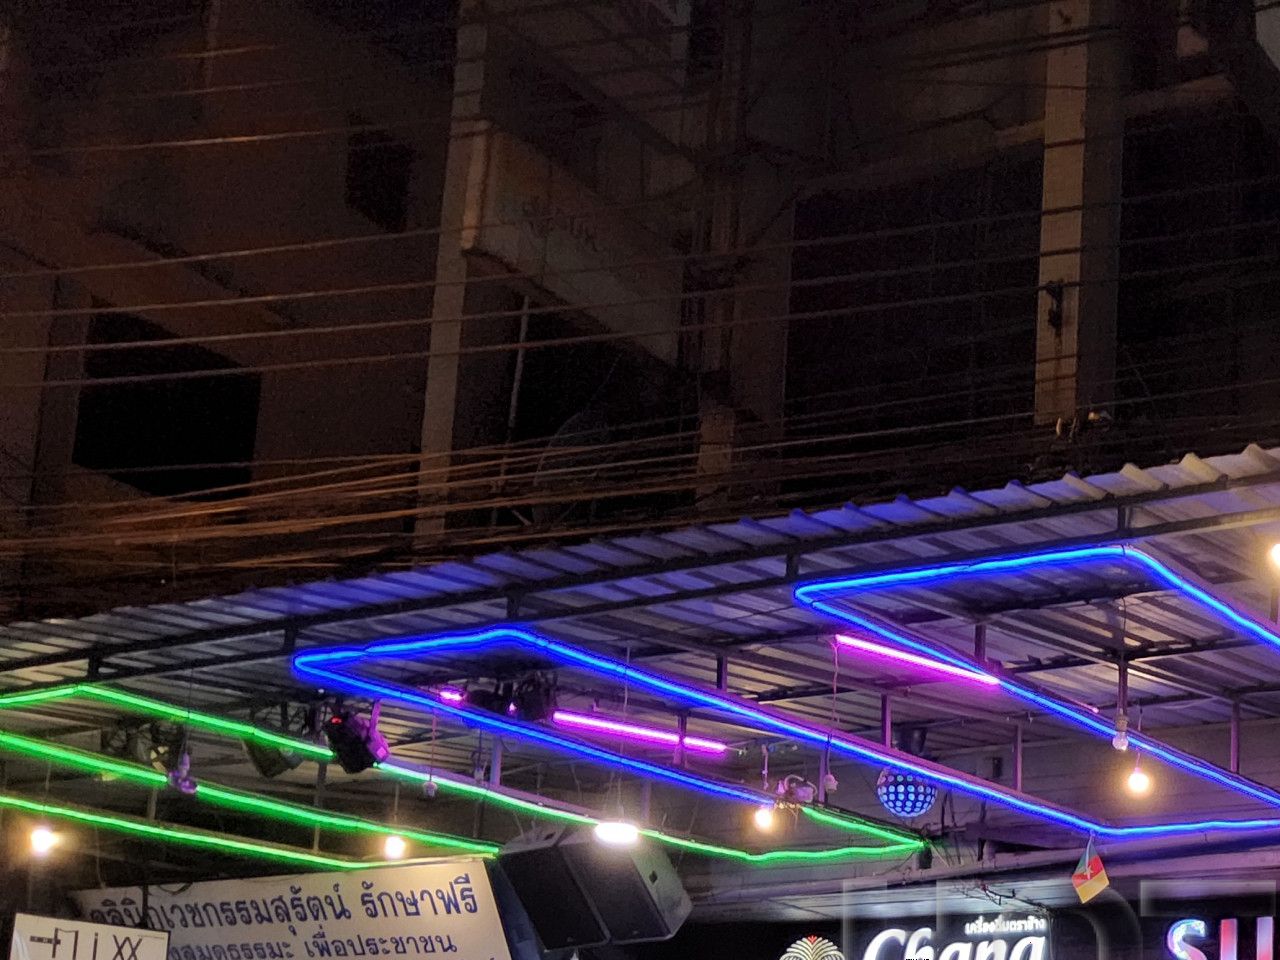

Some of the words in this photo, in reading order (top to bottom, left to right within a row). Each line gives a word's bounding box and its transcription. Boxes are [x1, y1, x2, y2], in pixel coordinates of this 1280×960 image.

[361, 873, 480, 919] รักษาฟรี
[304, 931, 458, 960] เพื่อประชาชน
